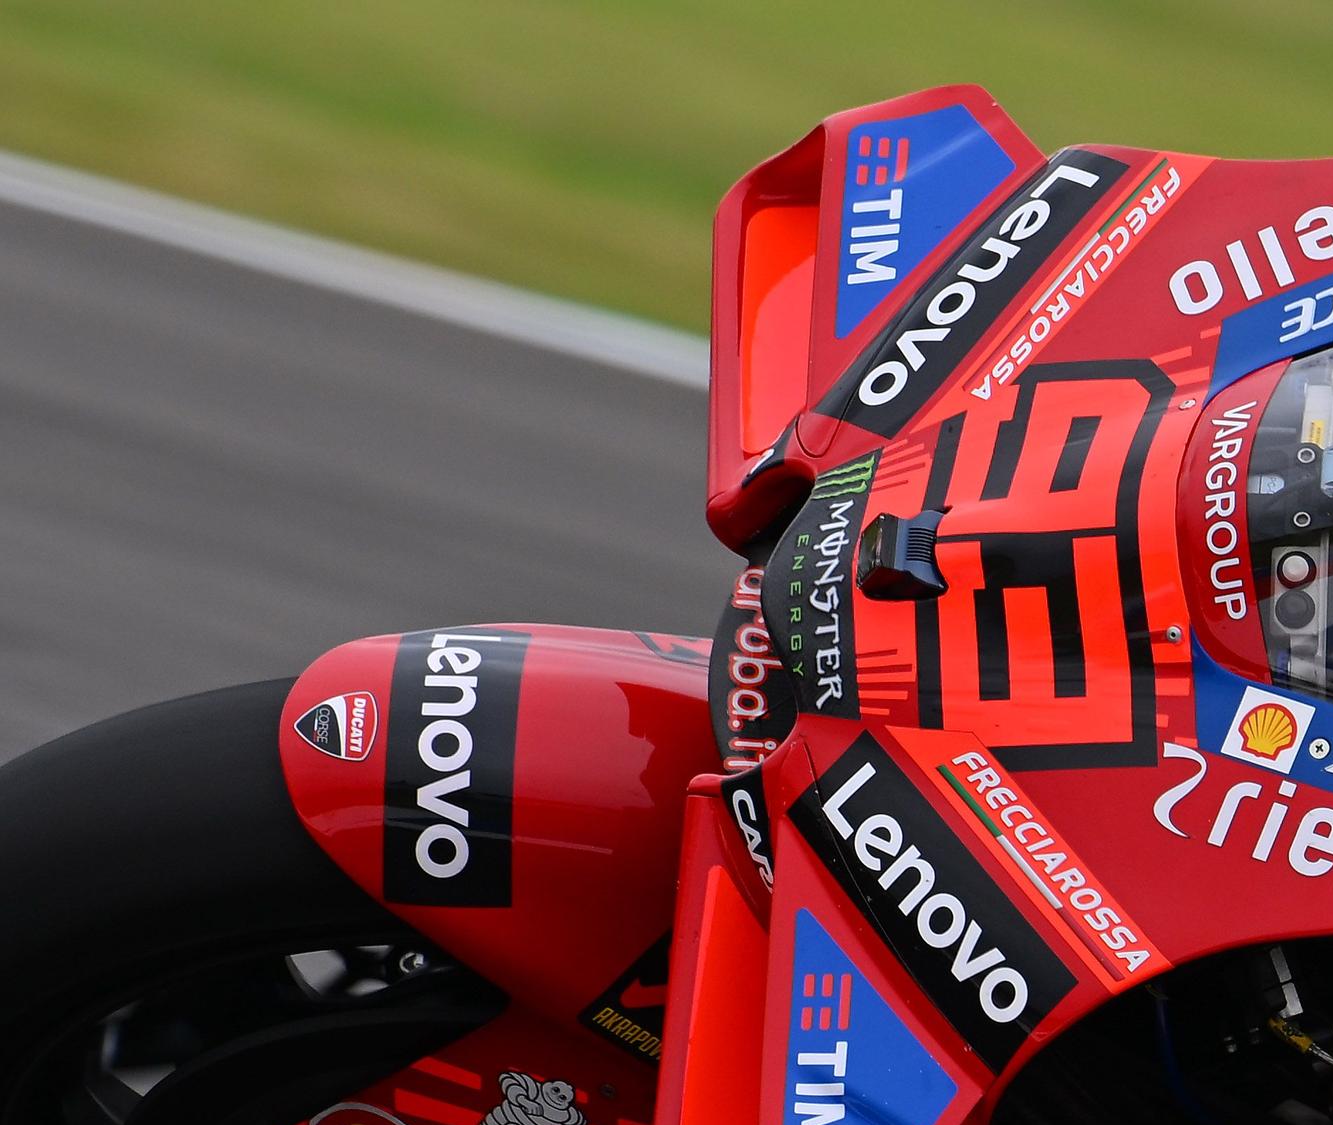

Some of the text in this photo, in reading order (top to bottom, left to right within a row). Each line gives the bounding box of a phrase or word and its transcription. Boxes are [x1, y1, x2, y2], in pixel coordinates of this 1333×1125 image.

[847, 188, 903, 285] TIM
[858, 164, 1100, 406] Lenovo
[970, 167, 1182, 400] FRECCIAROSSA
[789, 533, 808, 678] ENERGY
[810, 499, 856, 711] MONSTER
[925, 368, 1165, 760] 93
[1204, 400, 1257, 621] VARGROUP
[317, 708, 330, 744] CORSE
[350, 697, 366, 752] DUCATI
[415, 633, 502, 878] Lenovo
[821, 761, 1029, 1023] Lenovo
[950, 750, 1152, 973] FRECCIAROSSA
